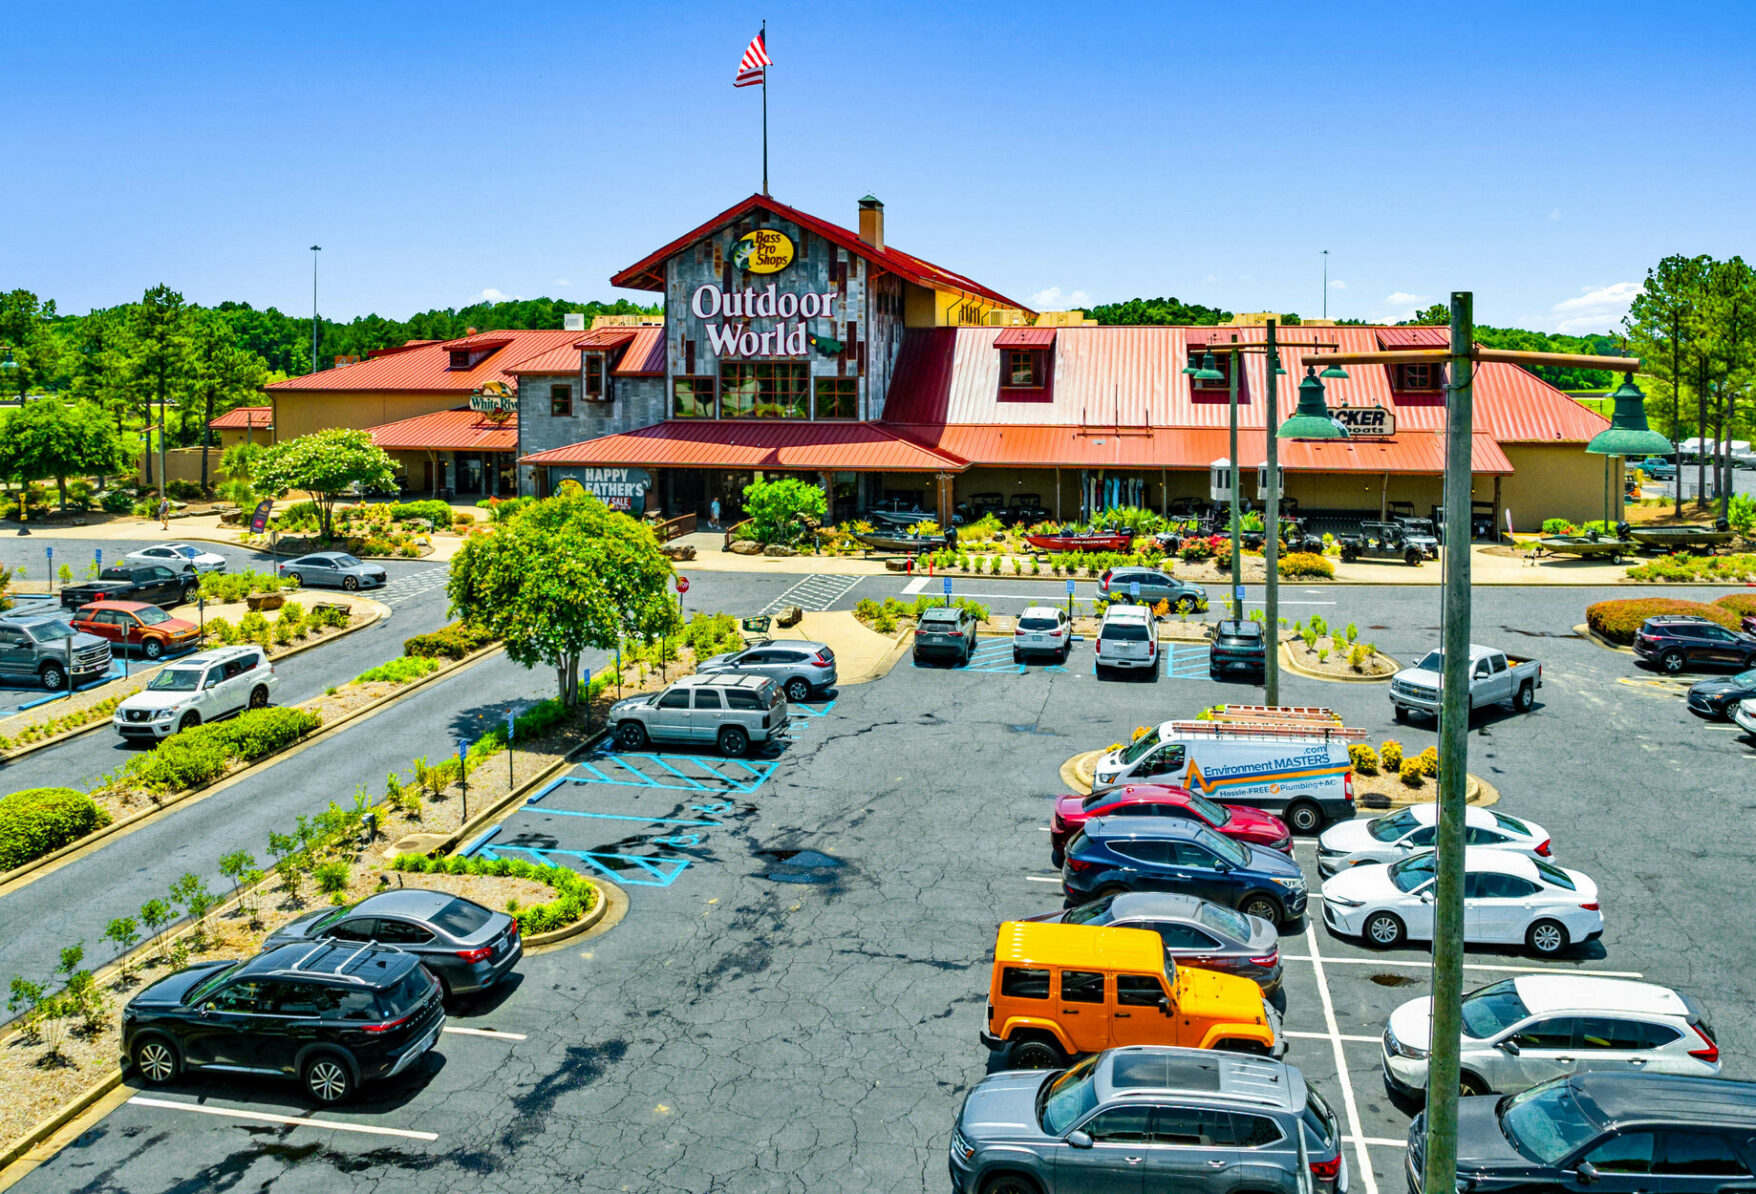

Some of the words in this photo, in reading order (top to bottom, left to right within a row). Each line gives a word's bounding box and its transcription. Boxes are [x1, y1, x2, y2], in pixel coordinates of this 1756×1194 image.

[755, 231, 781, 244] Bass
[757, 243, 776, 254] Pro
[756, 254, 788, 268] Shops
[691, 283, 838, 318] Outdoor
[704, 321, 808, 357] World
[470, 396, 498, 409] White
[500, 396, 518, 410] Riv
[1328, 410, 1385, 425] CKER
[585, 469, 628, 482] HAPPY
[585, 482, 644, 497] FATHER'S
[611, 497, 628, 506] SALE
[1303, 745, 1327, 755] .com
[1203, 761, 1273, 777] Environment
[1273, 753, 1330, 768] MASTERS
[1220, 785, 1270, 797] Hassle-FREE
